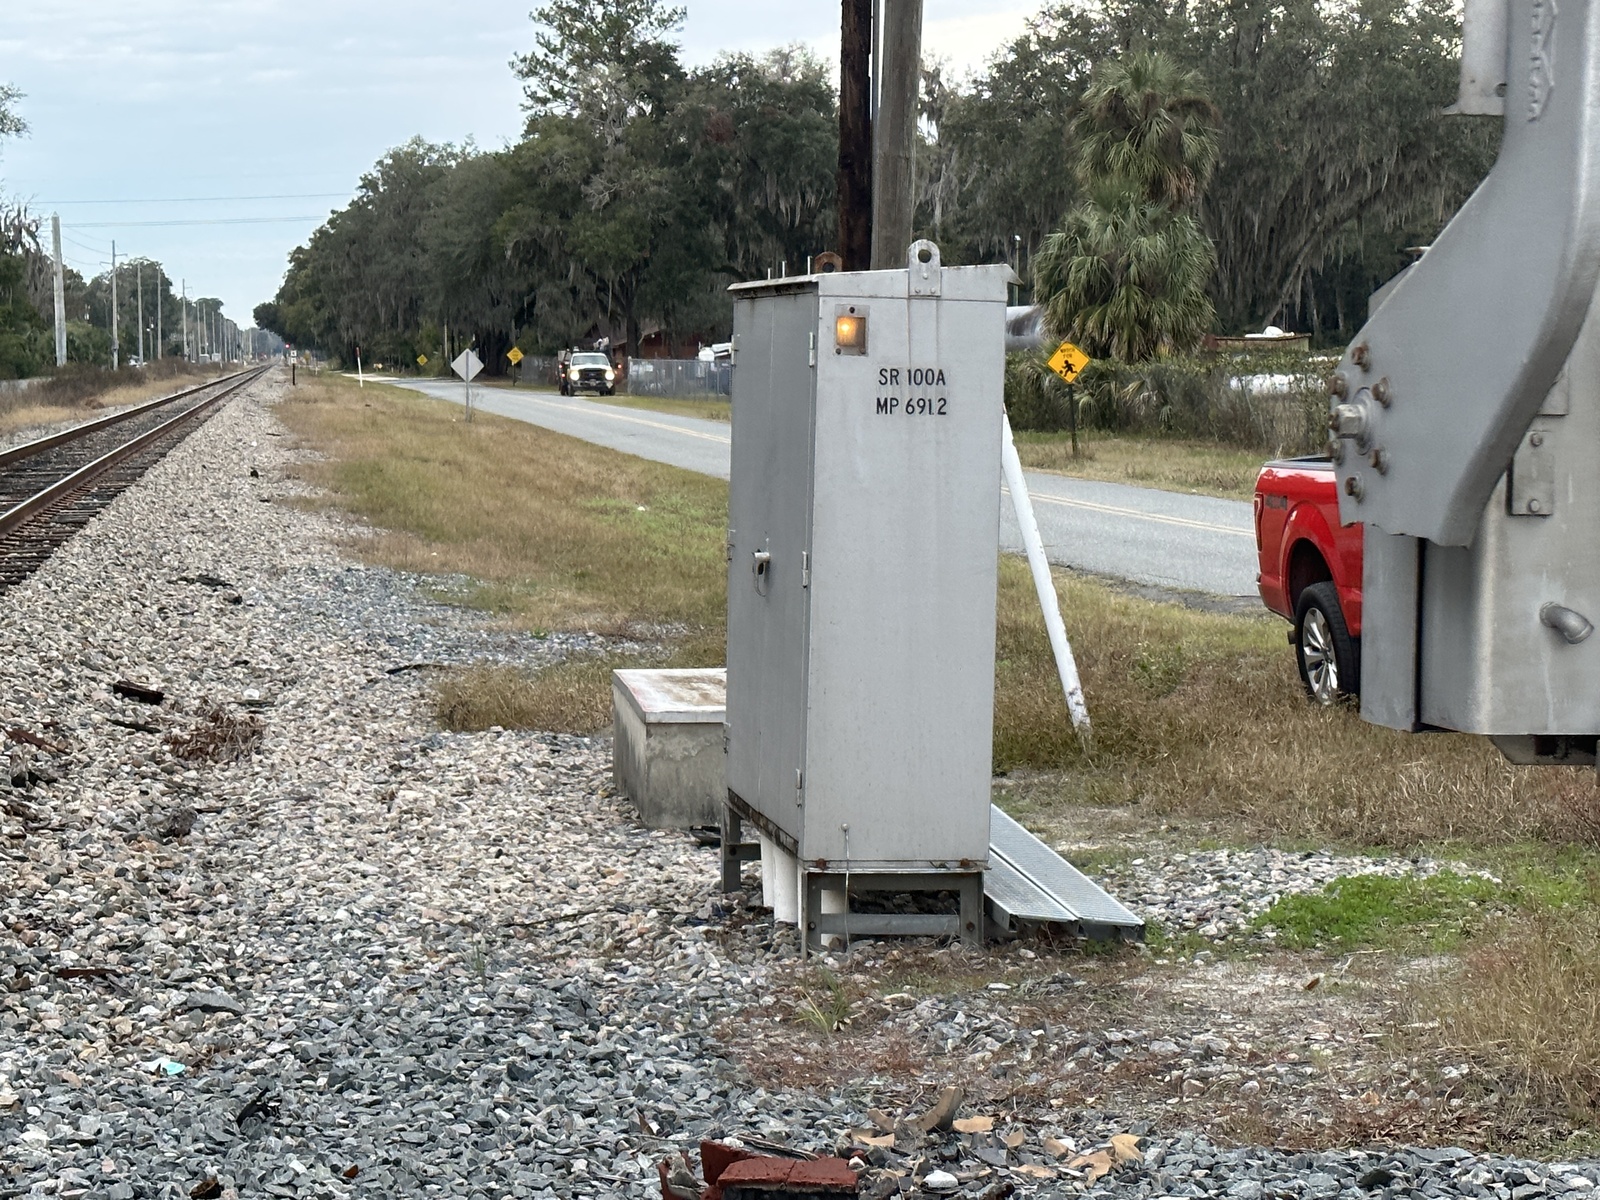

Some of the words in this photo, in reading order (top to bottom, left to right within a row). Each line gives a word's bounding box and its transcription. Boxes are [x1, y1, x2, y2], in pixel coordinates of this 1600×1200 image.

[878, 368, 900, 386] SR
[907, 368, 946, 386] 100A
[876, 397, 899, 415] MP
[905, 397, 947, 415] 691.2
